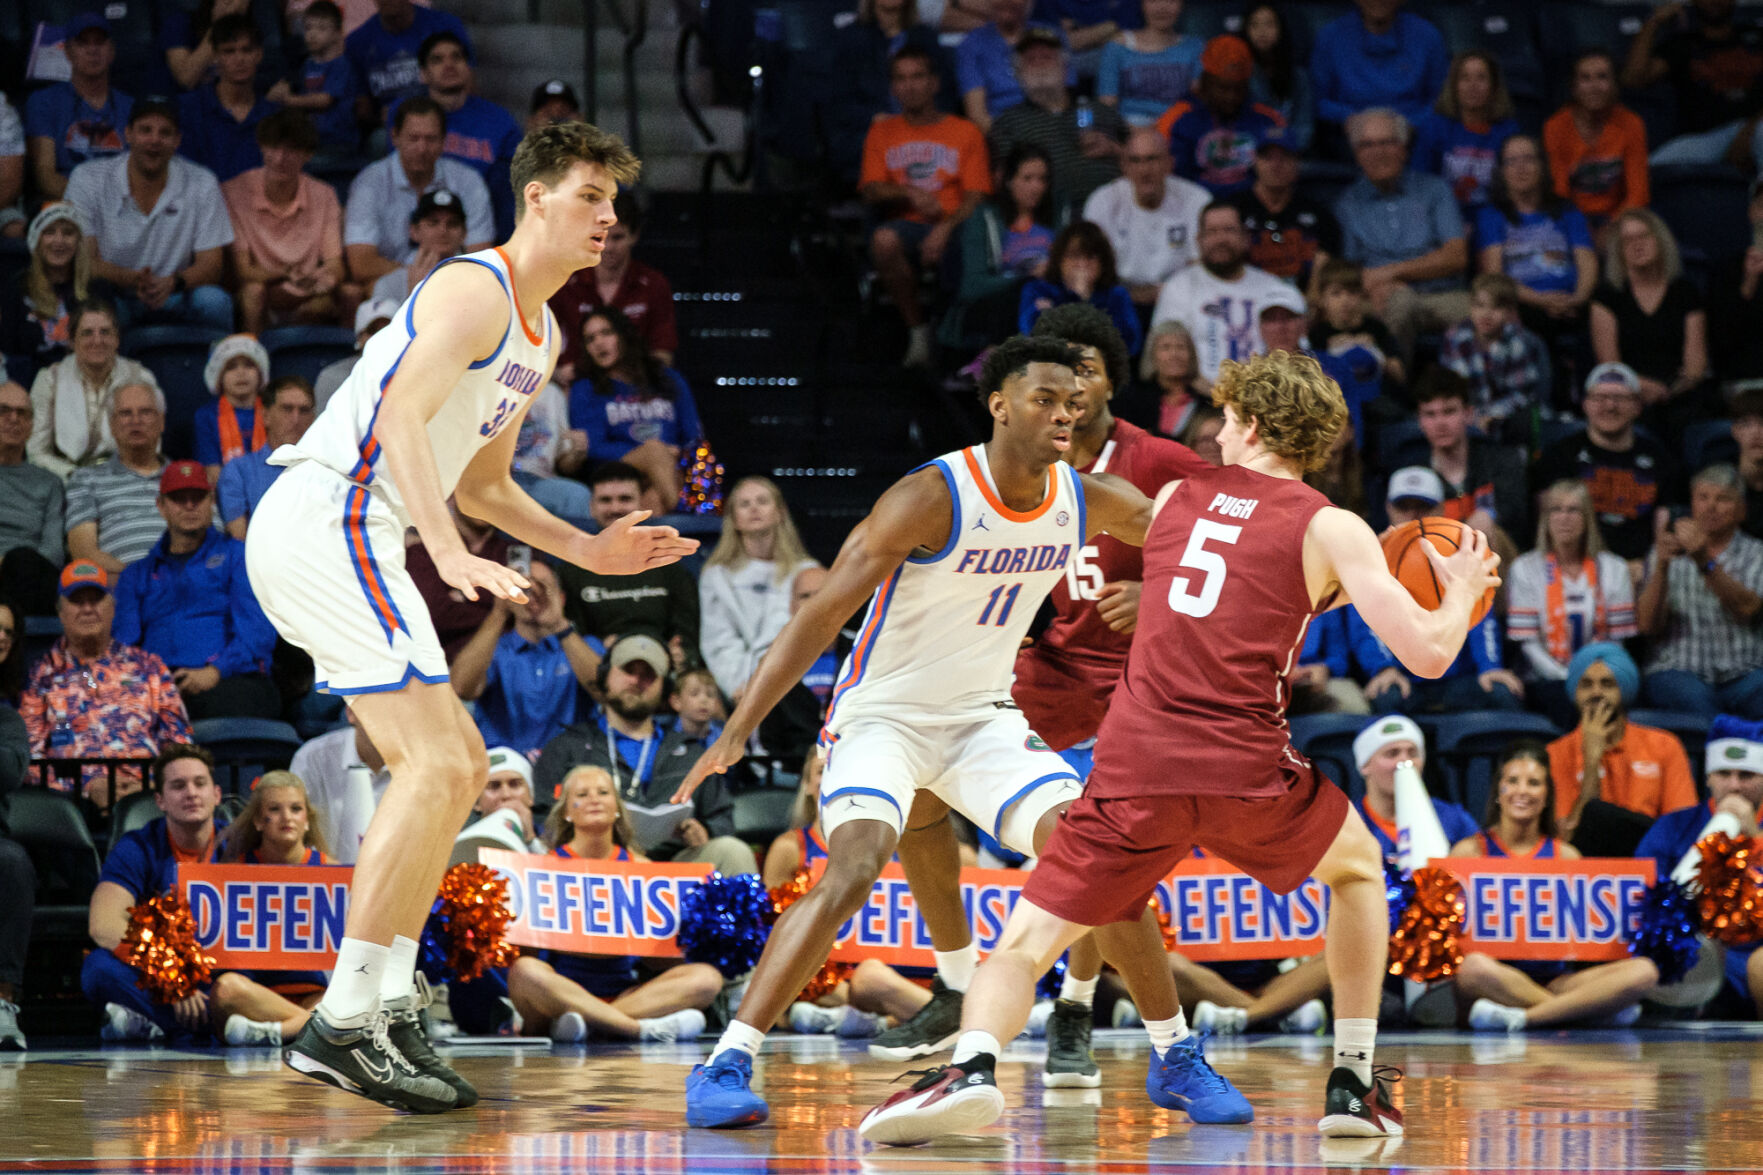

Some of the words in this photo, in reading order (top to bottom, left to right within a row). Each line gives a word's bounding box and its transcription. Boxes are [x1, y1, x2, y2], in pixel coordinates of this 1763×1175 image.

[1207, 492, 1260, 520] PUGH
[953, 543, 1072, 575] FLORIDA
[1066, 545, 1105, 601] 15
[1168, 517, 1244, 618] 5
[976, 582, 1024, 628] 11
[186, 880, 350, 953] DEFEN
[1154, 873, 1331, 946] EFENS
[1459, 872, 1646, 944] EFENSE
